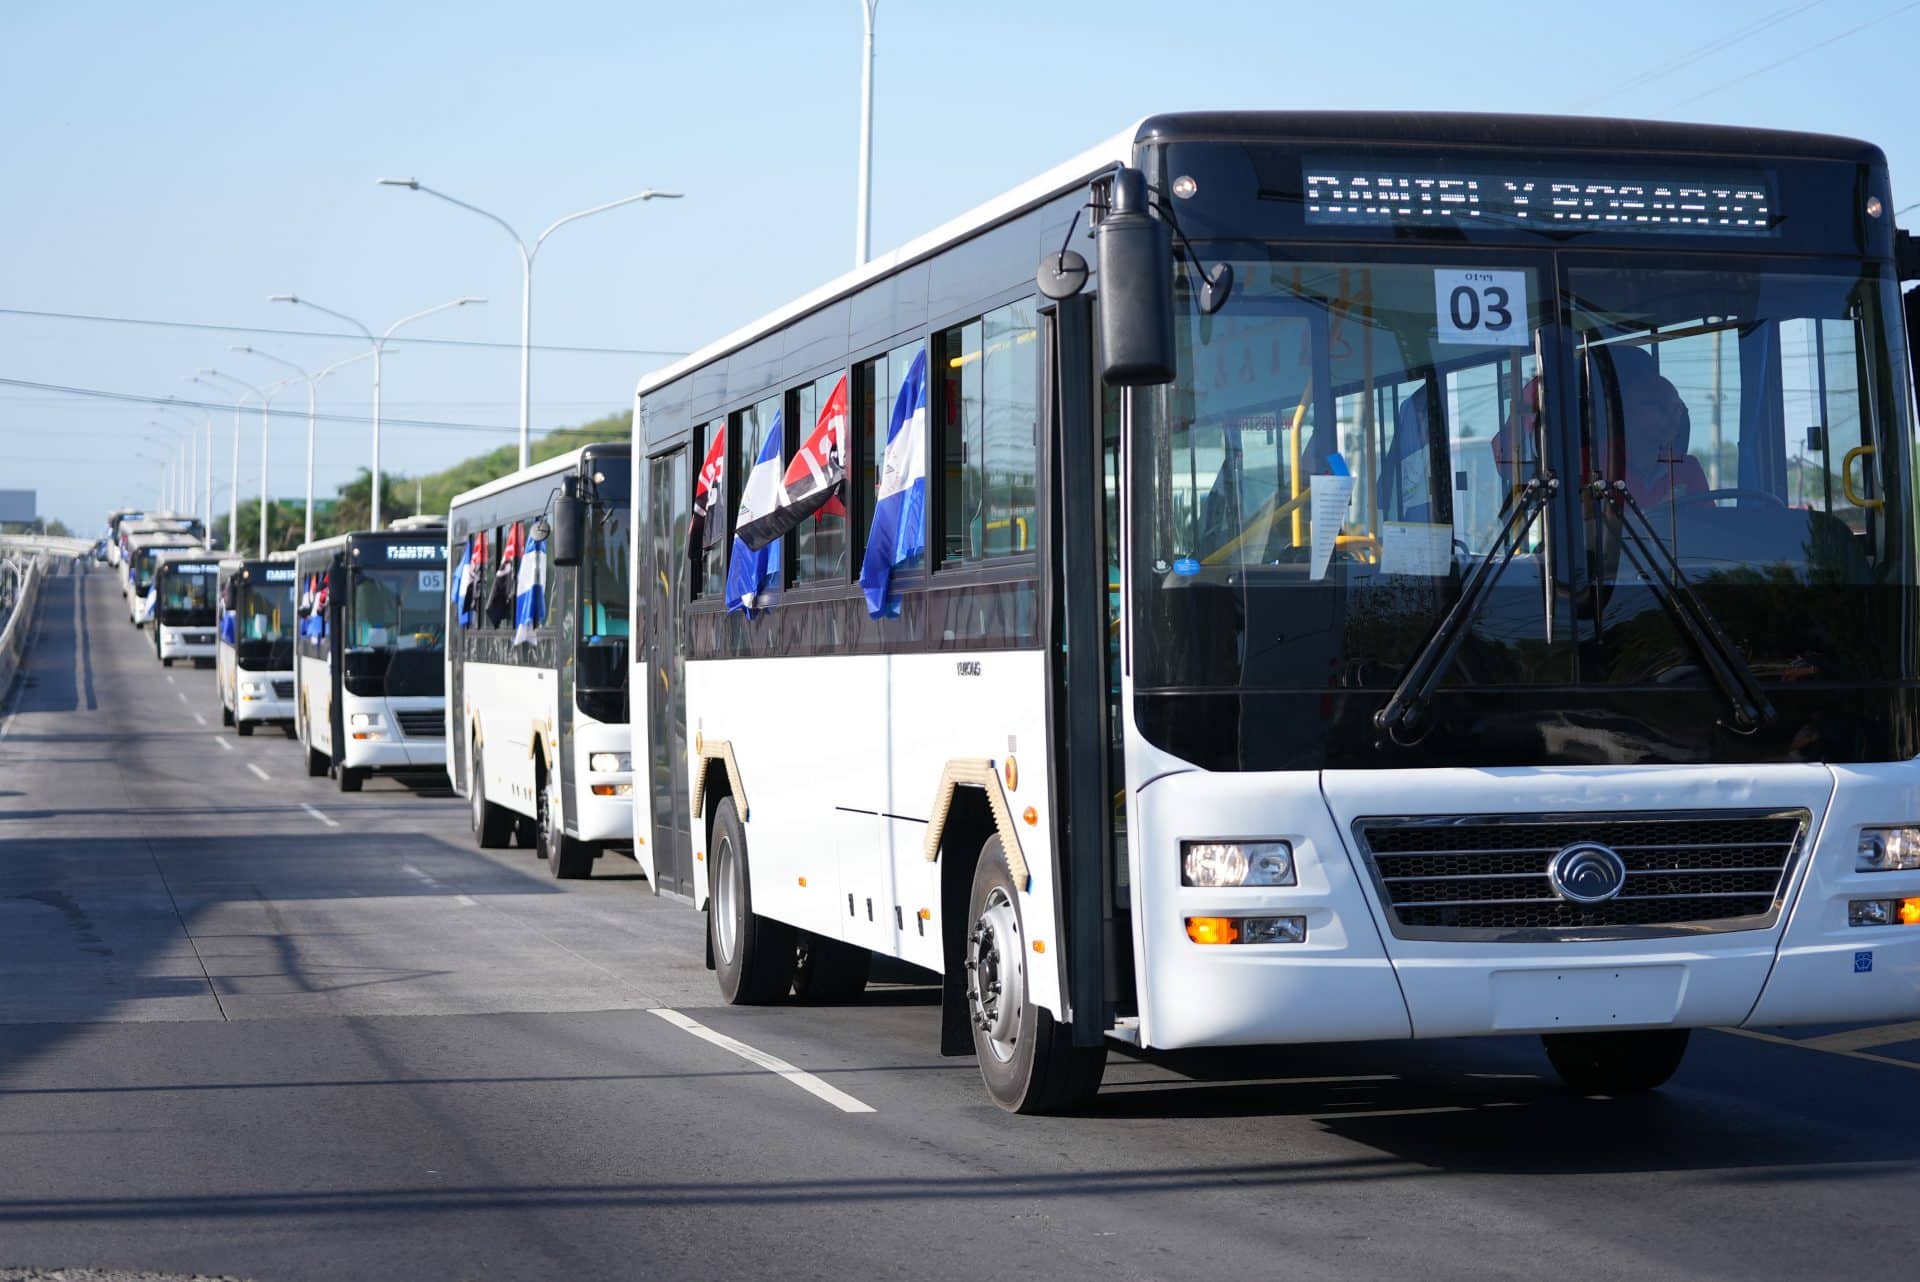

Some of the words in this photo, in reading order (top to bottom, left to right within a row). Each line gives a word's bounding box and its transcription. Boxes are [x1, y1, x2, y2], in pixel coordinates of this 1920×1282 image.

[1504, 183, 1535, 217] Y
[1449, 285, 1512, 331] 03
[422, 575, 441, 589] 05
